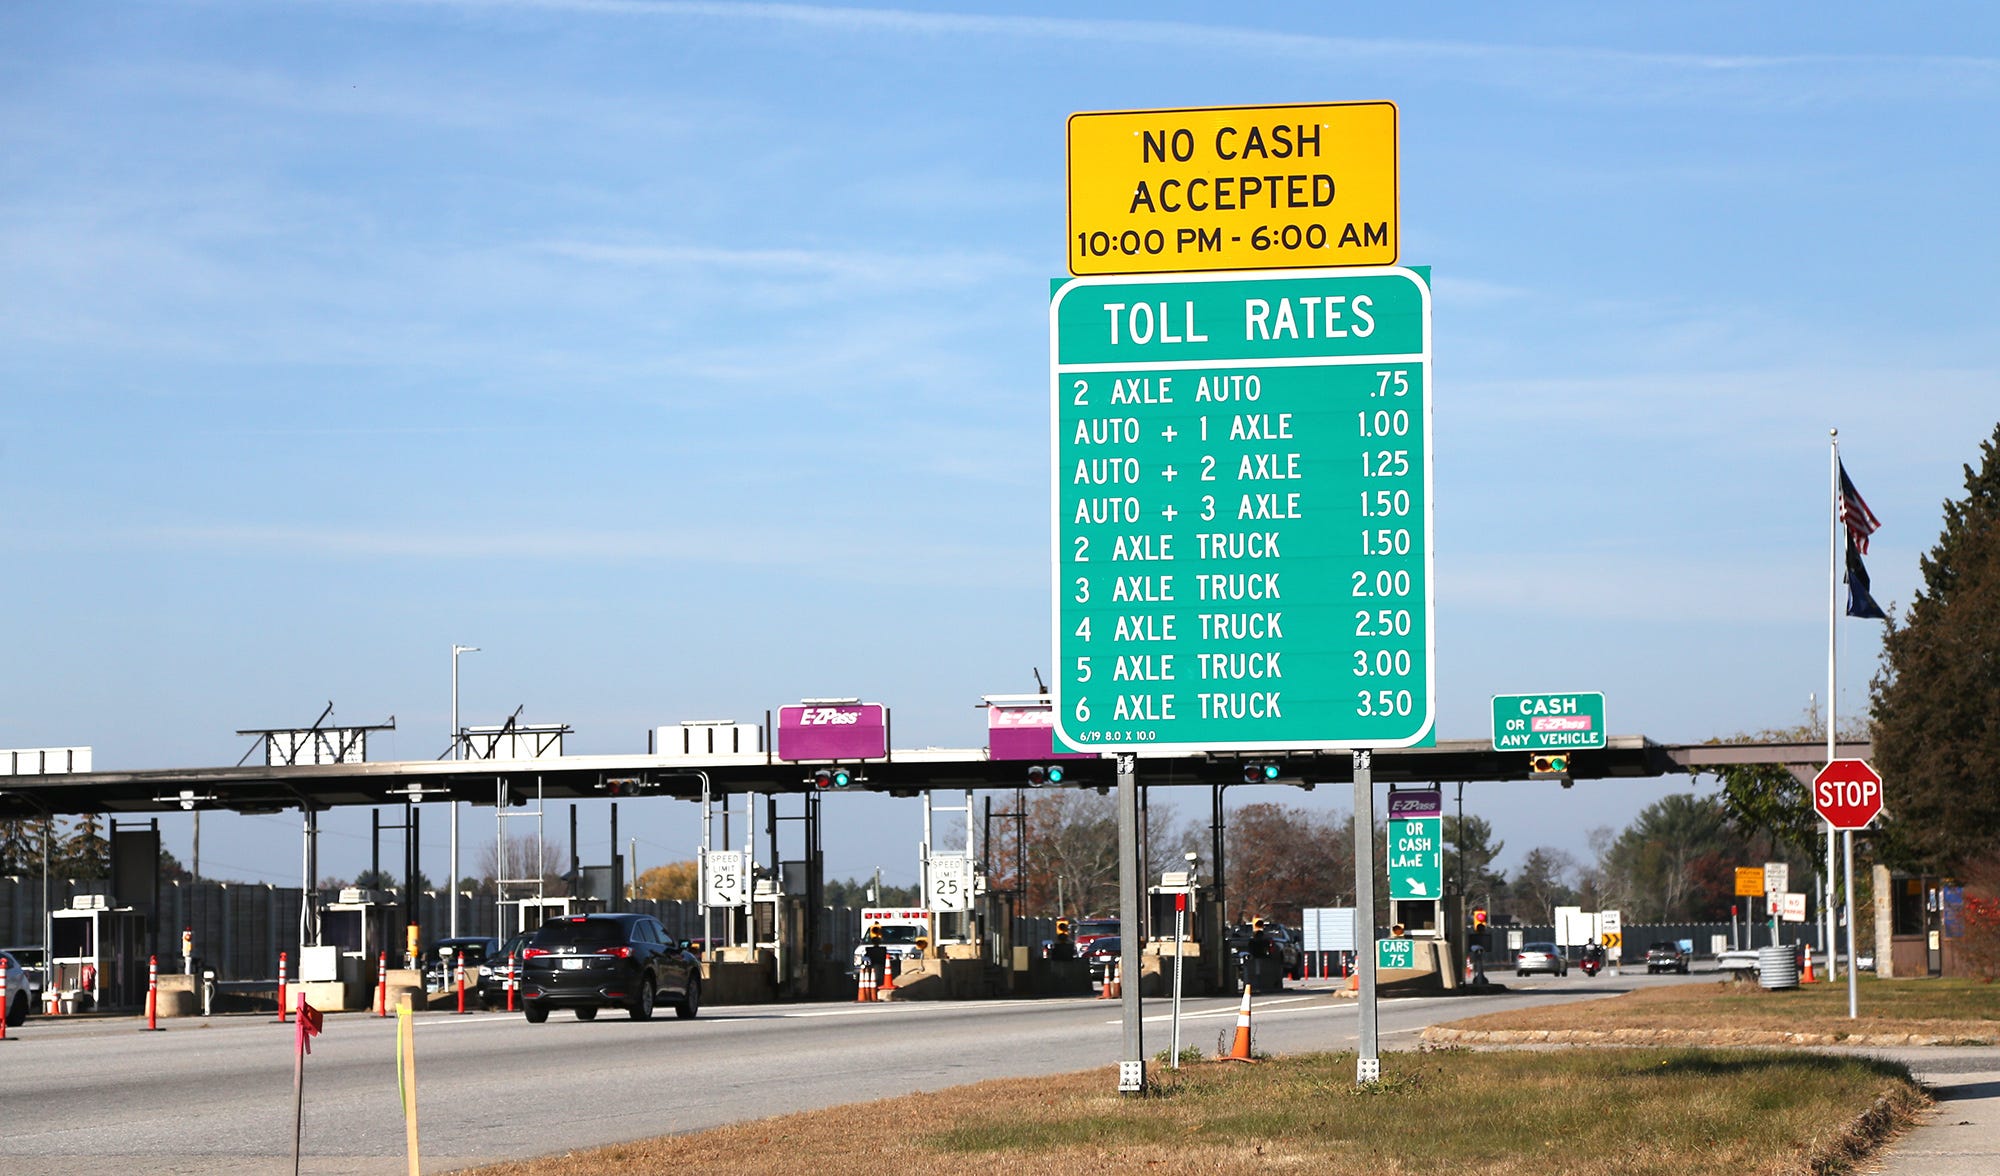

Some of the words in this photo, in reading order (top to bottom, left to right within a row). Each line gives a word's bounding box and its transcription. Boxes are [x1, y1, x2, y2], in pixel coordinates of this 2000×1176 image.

[1143, 128, 1195, 164] NO
[1215, 124, 1320, 161] CASH
[1129, 174, 1336, 214] ACCEPTED
[1078, 229, 1165, 257] 10:00
[1177, 227, 1222, 254] PM
[1251, 223, 1327, 251] 6:00
[1337, 221, 1388, 248] AM
[1103, 301, 1208, 345] TOLL
[1245, 294, 1375, 341] RATES
[1073, 379, 1089, 406] 2
[1110, 377, 1173, 405] AXLE
[1195, 374, 1261, 402] AUTO
[1370, 370, 1409, 398] .75
[1074, 417, 1140, 445] AUTO
[1161, 425, 1178, 443] +
[1200, 415, 1207, 441] 1
[1229, 413, 1293, 441] AXLE
[1358, 409, 1409, 437] 1.00
[1073, 457, 1140, 485] AUTO
[1161, 464, 1178, 482] +
[1200, 455, 1216, 481] 2
[1237, 453, 1302, 480] AXLE
[1362, 450, 1409, 477] 1.25
[1074, 496, 1140, 524] AUTO
[1161, 504, 1178, 522] +
[1200, 495, 1216, 521] 3
[1237, 493, 1302, 520] AXLE
[1360, 489, 1410, 517] 1.50
[1074, 536, 1090, 562] 2
[1112, 534, 1174, 561] AXLE
[1196, 532, 1280, 559] TRUCK
[1361, 528, 1411, 556] 1.50
[1075, 577, 1090, 603] 3
[1112, 575, 1174, 602] AXLE
[1195, 573, 1281, 600] TRUCK
[1351, 569, 1411, 597] 2.00
[1075, 616, 1092, 642] 4
[1113, 614, 1177, 642] AXLE
[1198, 612, 1283, 640] TRUCK
[1355, 609, 1411, 637] 2.50
[1077, 656, 1092, 683] 5
[1112, 654, 1175, 682] AXLE
[1197, 652, 1282, 680] TRUCK
[1353, 649, 1411, 677] 3.00
[1075, 696, 1091, 722] 6
[1113, 694, 1176, 721] AXLE
[1197, 692, 1282, 719] TRUCK
[1356, 689, 1412, 717] 3.50
[1519, 697, 1577, 715] CASH
[799, 707, 859, 726] E-ZPass
[1505, 719, 1525, 731] OR
[1079, 731, 1101, 742] 6/19
[1105, 731, 1122, 741] 8.0
[1125, 731, 1132, 741] X
[1136, 730, 1156, 741] 10.0
[1500, 734, 1531, 746] ANY
[1539, 732, 1599, 745] VEHICLE
[1818, 780, 1877, 808] STOP
[1391, 800, 1436, 811] E-ZPass
[1406, 822, 1424, 836] OR
[1398, 837, 1431, 852] CASH
[711, 855, 739, 863] SPEED
[932, 860, 961, 869] SPEED
[1433, 852, 1439, 868] 1
[713, 865, 735, 873] LIMIT
[935, 871, 957, 879] LIMIT
[714, 874, 736, 889] 25
[936, 880, 958, 895] 25
[1382, 941, 1410, 953] CARS
[1387, 954, 1405, 967] .75
